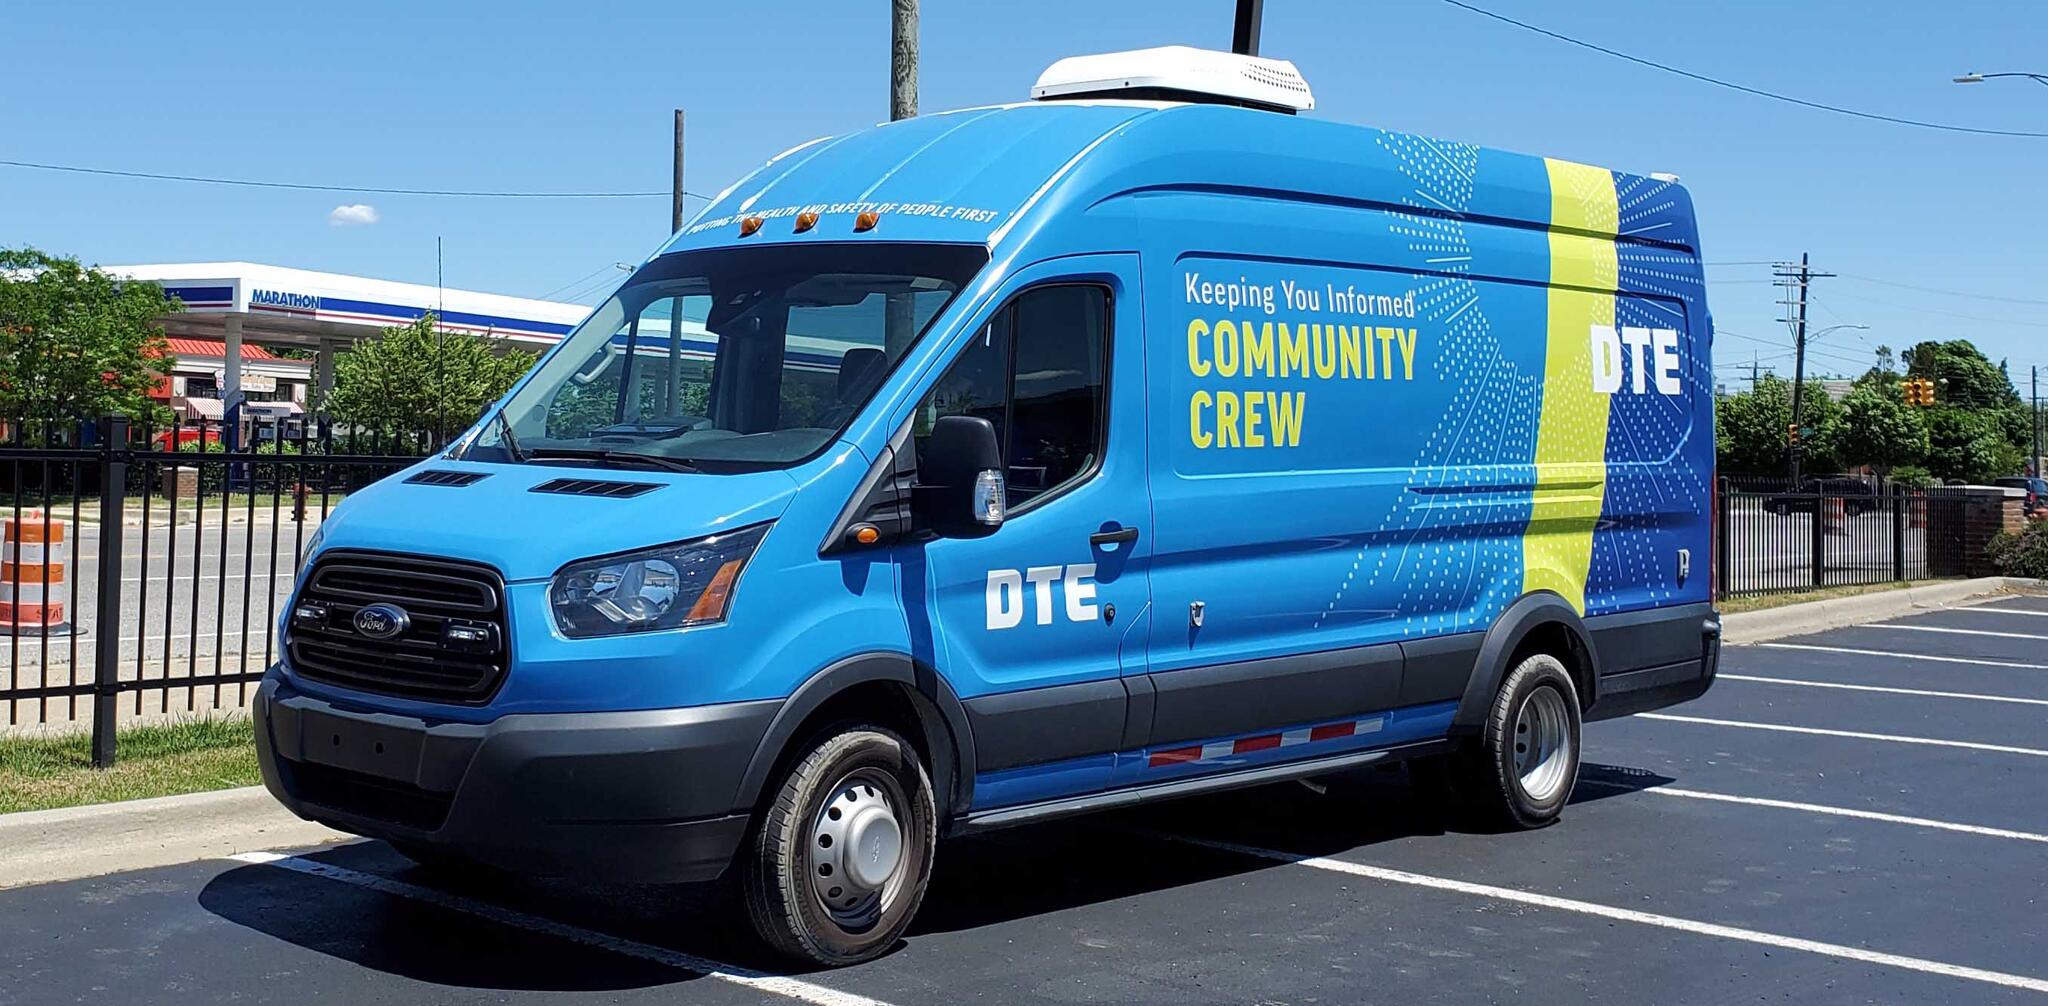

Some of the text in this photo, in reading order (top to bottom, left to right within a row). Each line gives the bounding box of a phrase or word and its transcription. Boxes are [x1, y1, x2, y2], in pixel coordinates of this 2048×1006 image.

[686, 215, 734, 235] PUTTING
[757, 206, 800, 219] HEALTH
[799, 203, 829, 214] AND
[827, 202, 879, 214] SAFETY
[875, 203, 899, 214] OF
[896, 203, 953, 218] PEOPLE
[951, 207, 998, 223] FIRST
[252, 288, 320, 309] MARATHON
[1185, 272, 1416, 319] Keeping You Informed
[1187, 318, 1418, 381] COMMUNITY
[1590, 324, 1681, 396] DTE
[1190, 390, 1306, 449] CREW
[360, 611, 388, 632] Ford
[985, 563, 1098, 630] DTE
